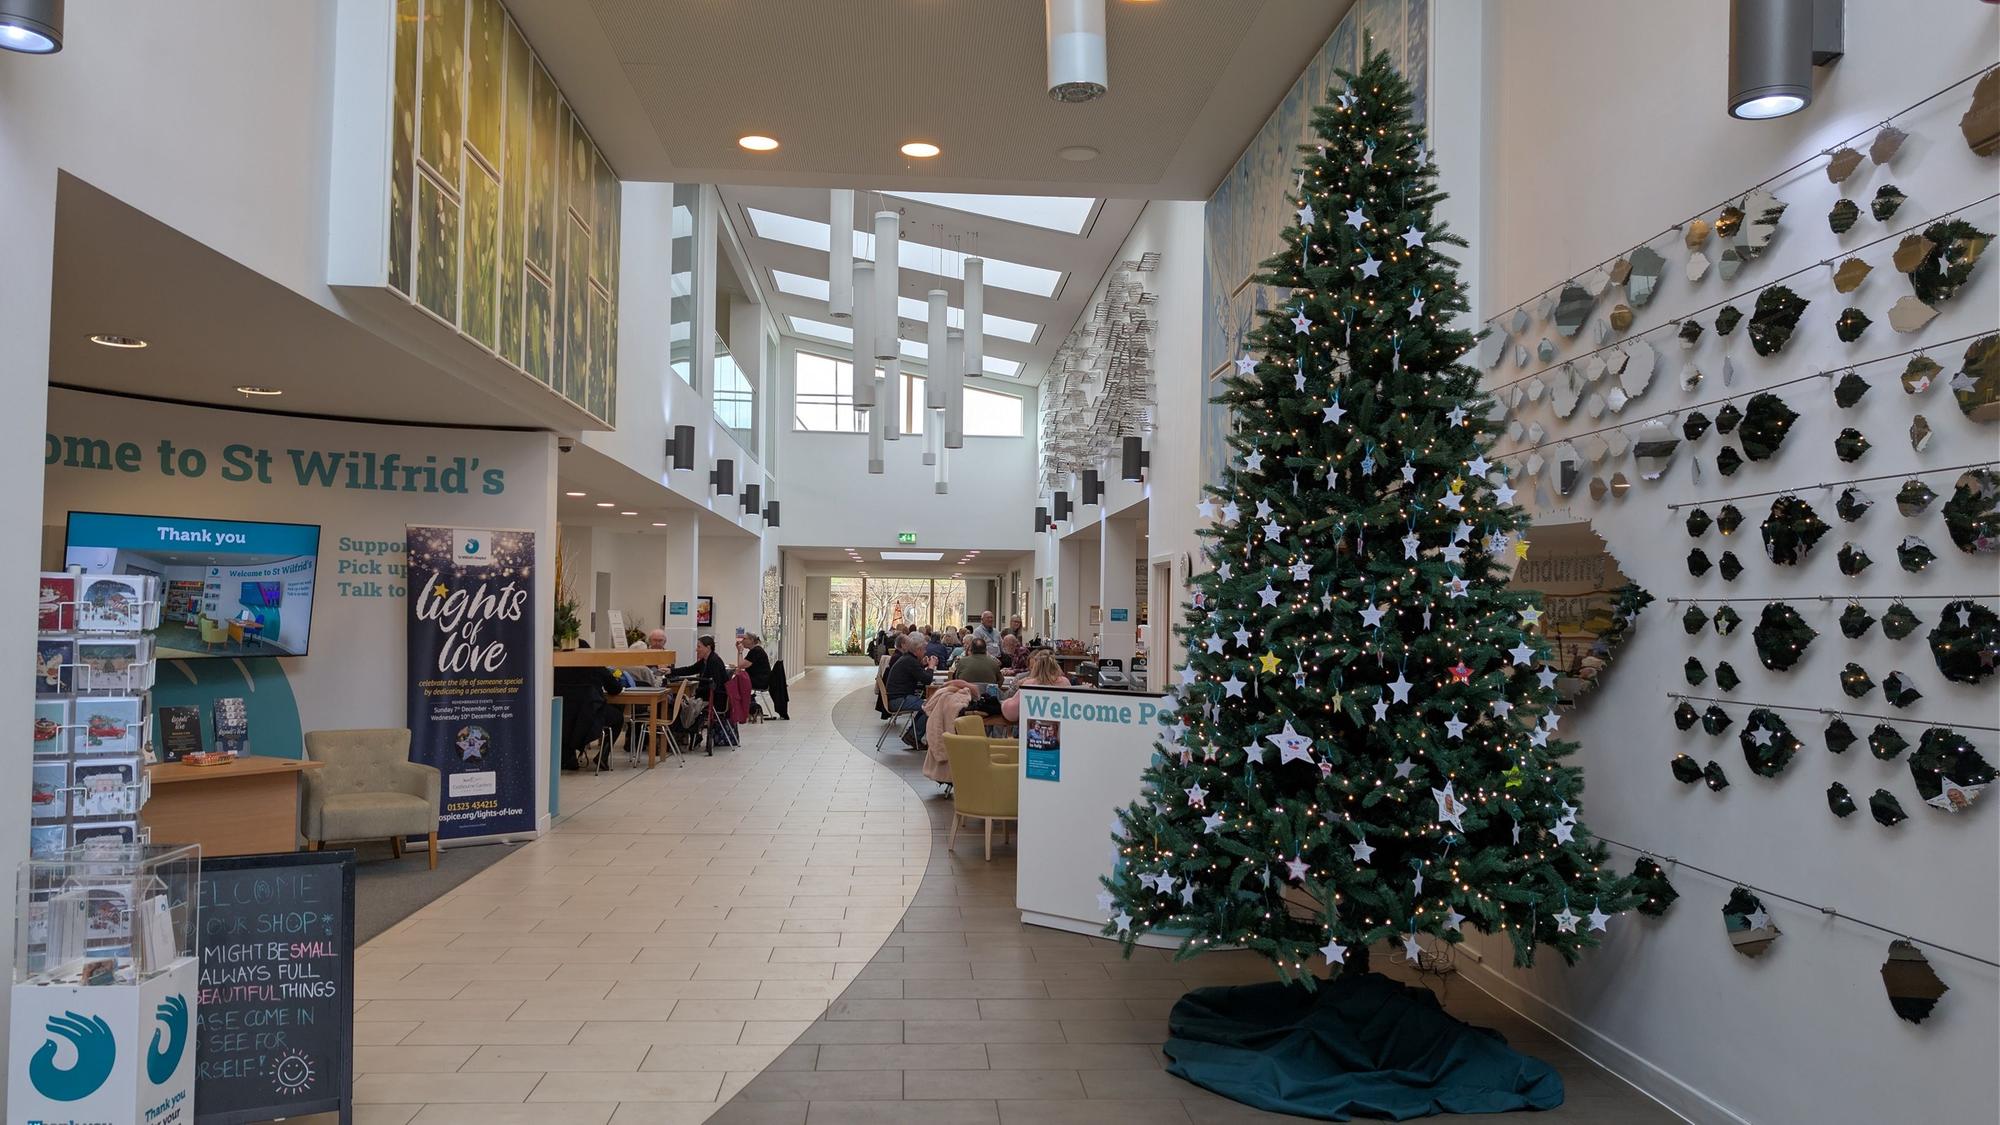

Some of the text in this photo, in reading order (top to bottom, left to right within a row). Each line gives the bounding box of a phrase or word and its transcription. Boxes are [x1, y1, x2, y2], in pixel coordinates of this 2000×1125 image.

[157, 439, 207, 478] to
[222, 444, 273, 484] St
[287, 449, 505, 495] Wilfrid's
[157, 526, 246, 546] Thank you
[229, 560, 312, 577] Welcome to St Wilfrid's
[338, 559, 382, 575] Pick
[1520, 551, 1605, 589] enduring
[337, 582, 406, 597] Talk to
[416, 572, 528, 632] lights
[462, 618, 483, 645] of
[438, 632, 508, 672] love
[419, 679, 447, 687] celebrate
[459, 678, 468, 687] life
[470, 678, 477, 687] of
[504, 677, 523, 686] special
[424, 688, 432, 696] by
[433, 687, 464, 696] dedicating
[1025, 696, 1132, 724] Welcome
[447, 800, 498, 811] 01323 434215
[257, 911, 317, 934] SHOP
[204, 944, 263, 964] MIGHT
[267, 942, 289, 961] BE
[290, 941, 339, 958] SMALL
[200, 963, 321, 985] ALWAYS FULL
[280, 981, 336, 1000] THINGS
[244, 1007, 290, 1027] COME
[297, 1006, 314, 1025] IN
[209, 1033, 249, 1053] SEE
[256, 1031, 289, 1051] FOR
[145, 1089, 186, 1122] Thank you
